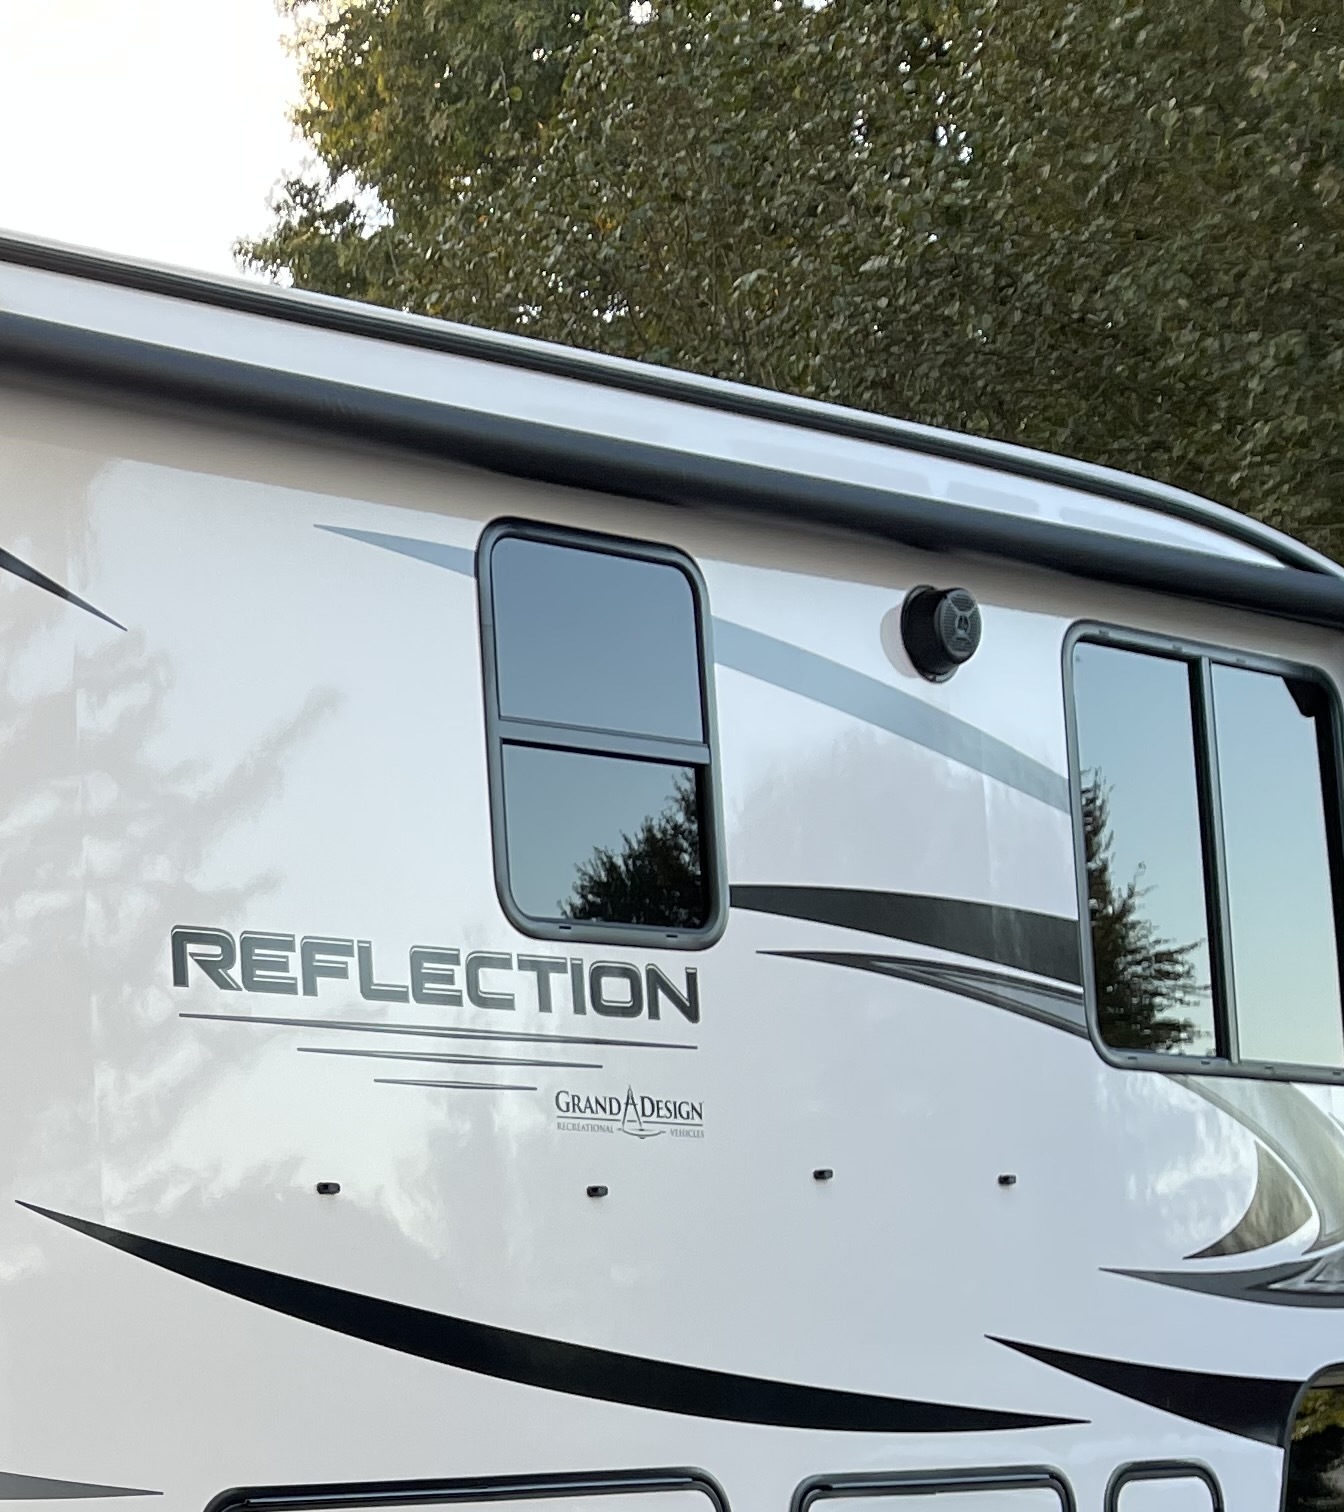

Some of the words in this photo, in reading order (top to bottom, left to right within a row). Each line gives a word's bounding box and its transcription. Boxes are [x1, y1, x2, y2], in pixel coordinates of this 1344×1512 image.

[171, 924, 700, 1024] REFLECTION
[555, 1090, 621, 1116] GRAND
[640, 1096, 703, 1121] DESIGN
[557, 1122, 614, 1133] RECREATIONAL
[670, 1128, 704, 1138] VEHICLES
